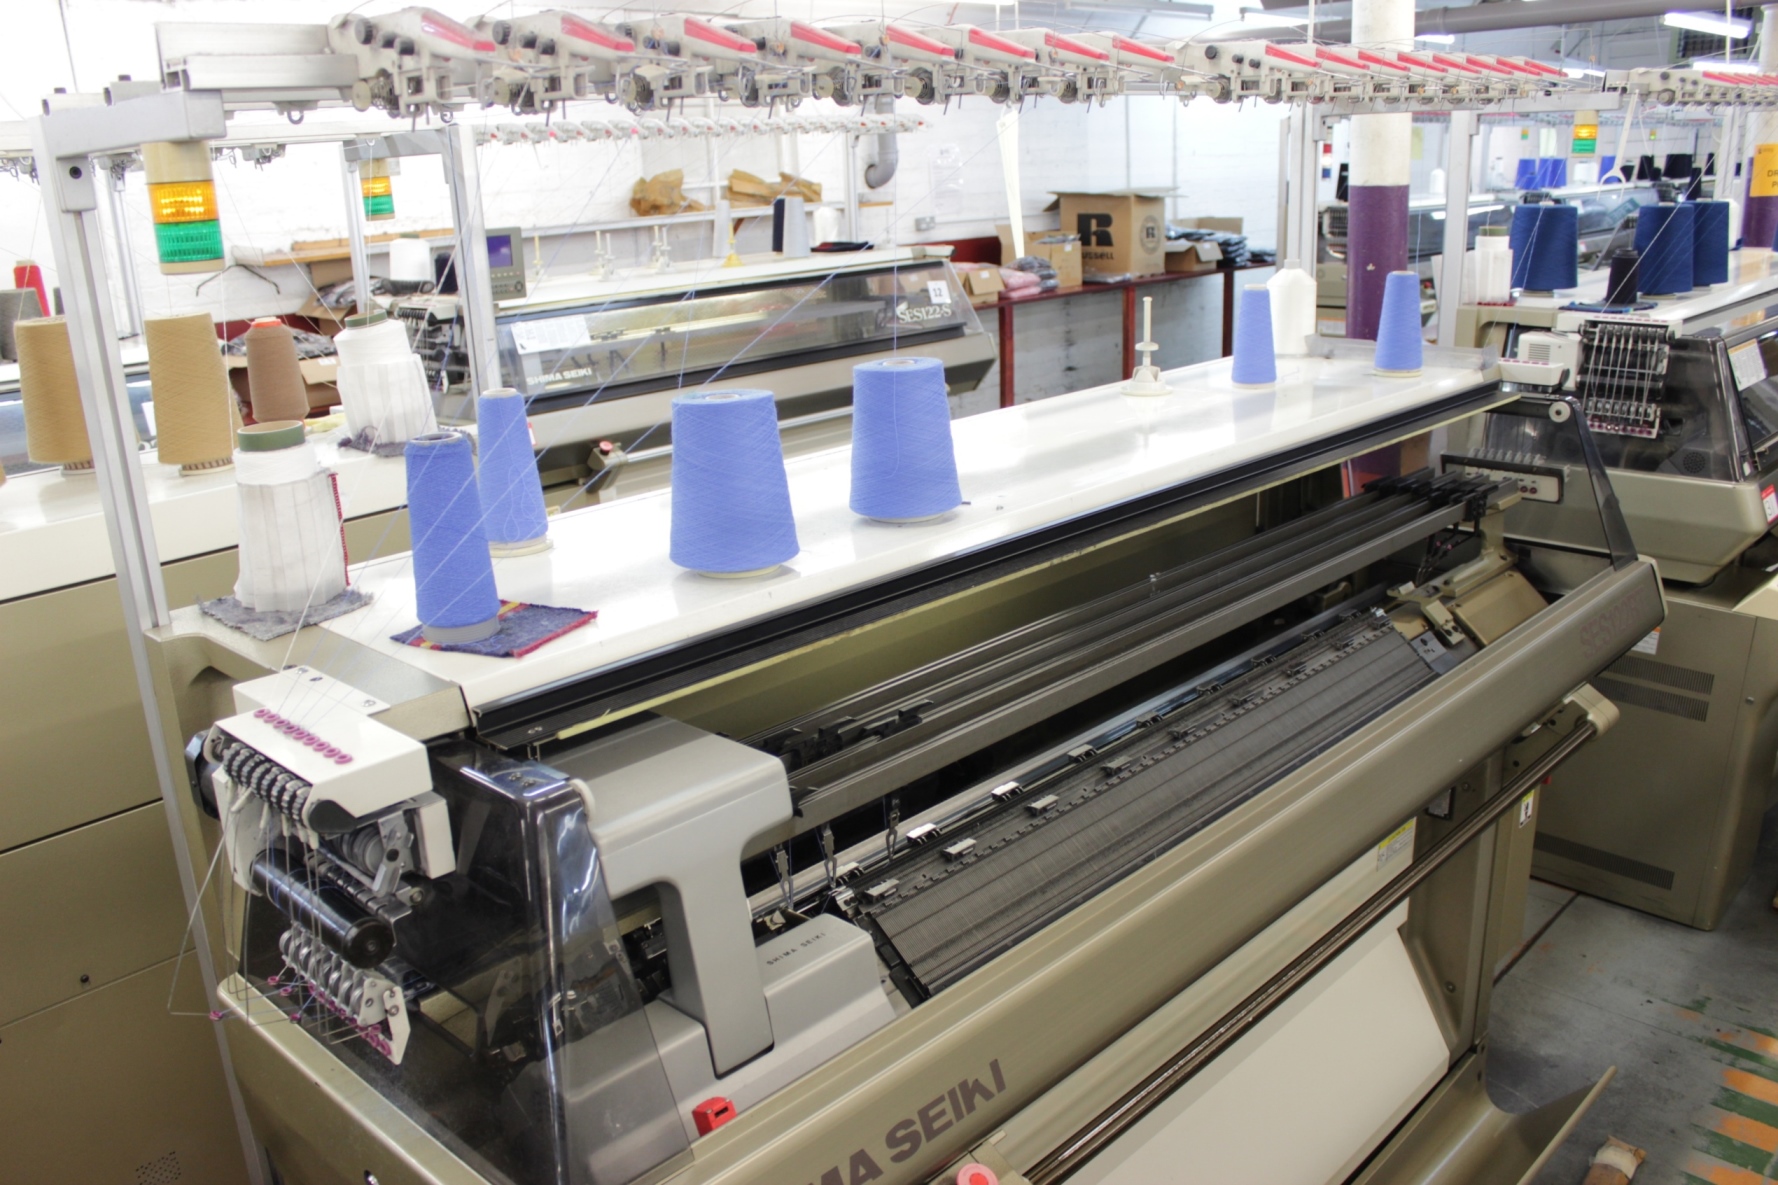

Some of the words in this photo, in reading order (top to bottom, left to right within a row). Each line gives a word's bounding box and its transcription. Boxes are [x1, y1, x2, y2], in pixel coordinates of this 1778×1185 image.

[1077, 213, 1114, 246] R
[933, 287, 943, 298] 12
[526, 372, 562, 385] SHIMA
[563, 368, 592, 379] SEIKI
[766, 948, 798, 966] SHIMA
[800, 932, 826, 947] SEIKI
[885, 1058, 1006, 1163] SEIKI
